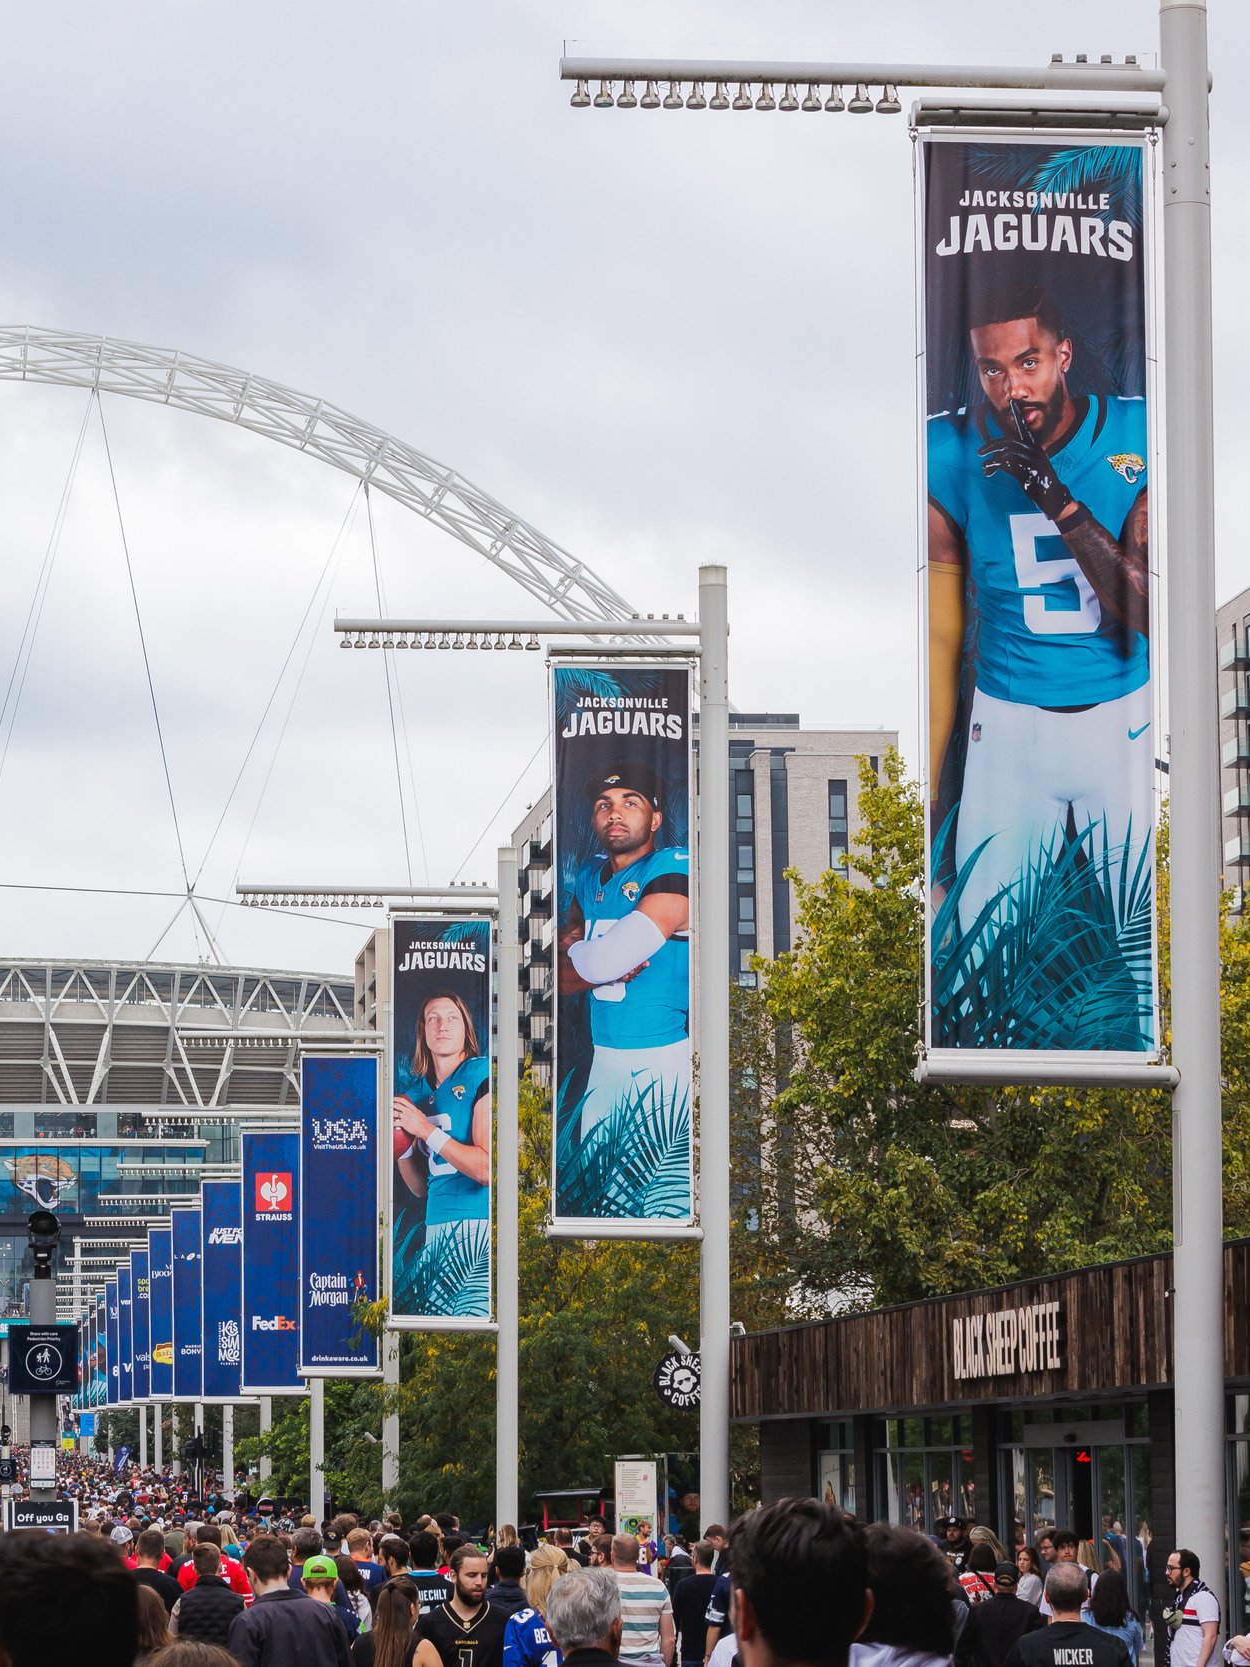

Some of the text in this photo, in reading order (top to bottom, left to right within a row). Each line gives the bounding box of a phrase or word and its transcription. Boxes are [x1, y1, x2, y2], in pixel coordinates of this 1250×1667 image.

[959, 189, 1110, 210] JACKSONVILLE
[935, 213, 1134, 262] JAGUARS
[576, 697, 669, 709] JACKSONVILLE
[562, 711, 683, 740] JAGUARS
[409, 941, 476, 950] JACKSONVILLE
[398, 951, 486, 973] JAGUARS
[312, 1118, 367, 1143] USA
[255, 1213, 292, 1221] STRAUSS
[310, 1272, 347, 1291] Captain
[308, 1290, 349, 1308] Morgan
[252, 1315, 296, 1331] FedEx
[953, 1301, 1061, 1379] BLACK SHEEP COFFEE
[659, 1356, 680, 1386] BLACK
[17, 1512, 69, 1524] Off you Go
[418, 1588, 447, 1601] UECHLY
[1053, 1648, 1093, 1666] WICKER
